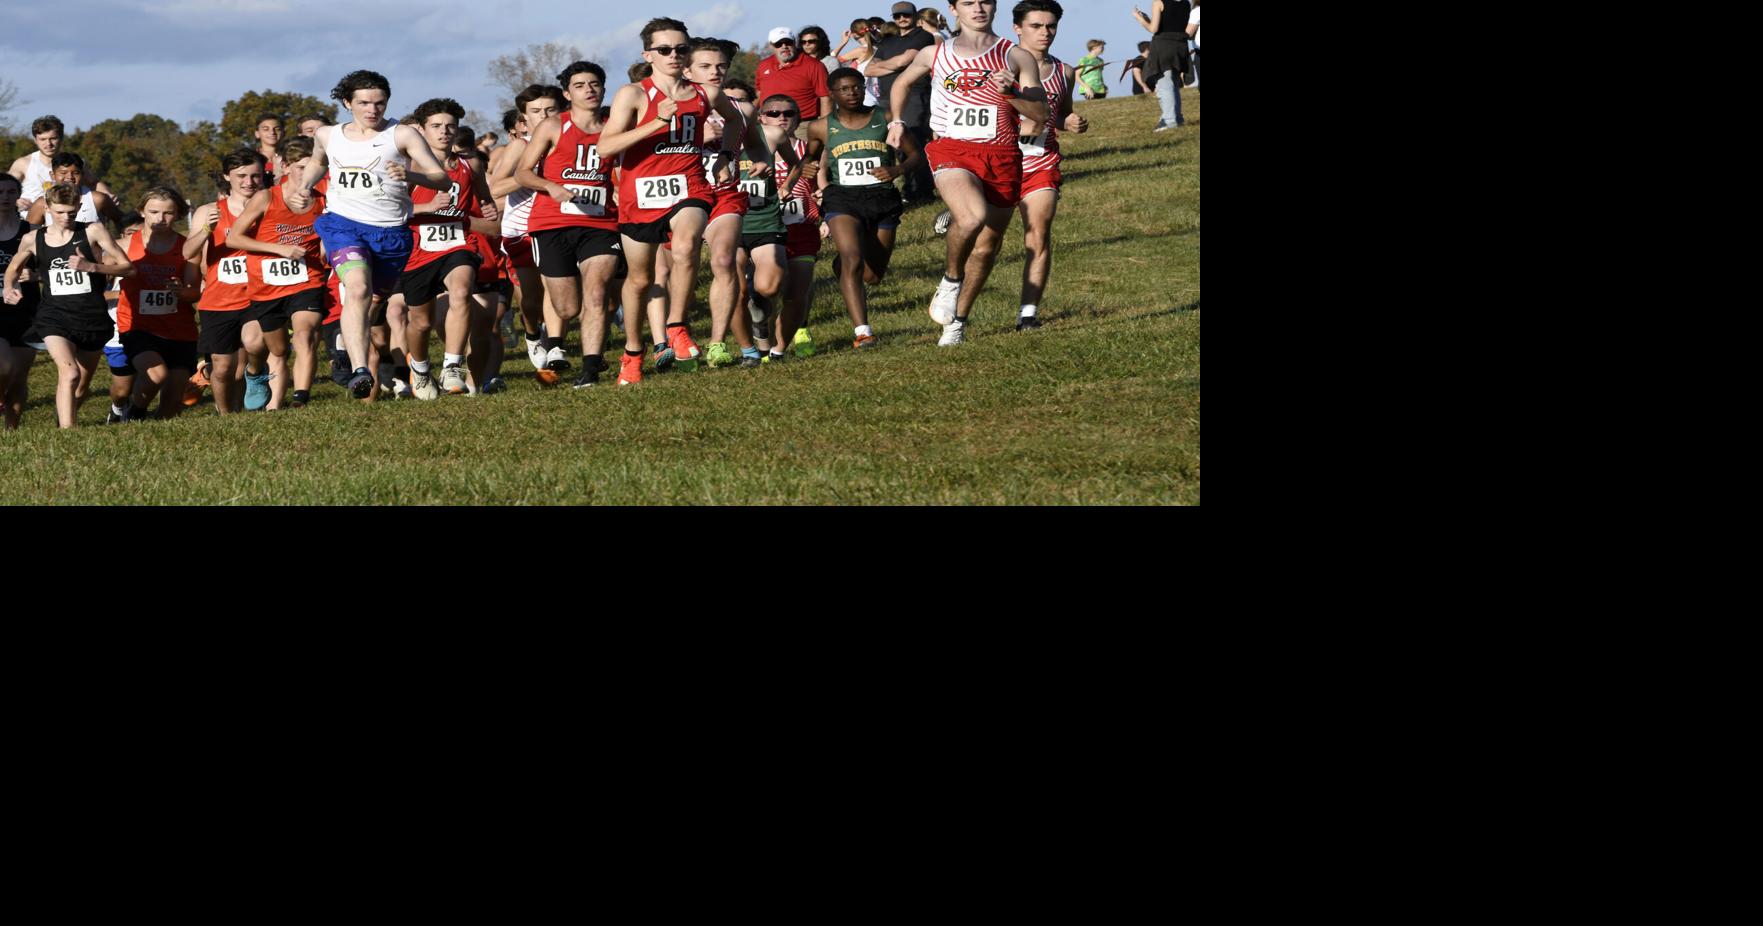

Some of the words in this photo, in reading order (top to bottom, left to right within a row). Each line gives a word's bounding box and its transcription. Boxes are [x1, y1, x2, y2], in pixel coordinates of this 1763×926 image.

[953, 107, 989, 127] 266
[669, 114, 697, 143] LB
[831, 139, 888, 159] NORTHSIDE
[844, 160, 875, 177] 299
[338, 171, 373, 189] 478
[643, 177, 681, 198] 286
[569, 188, 601, 206] 290
[426, 225, 457, 242] 291
[269, 259, 300, 277] 468
[55, 270, 84, 287] 450
[145, 292, 174, 306] 466
